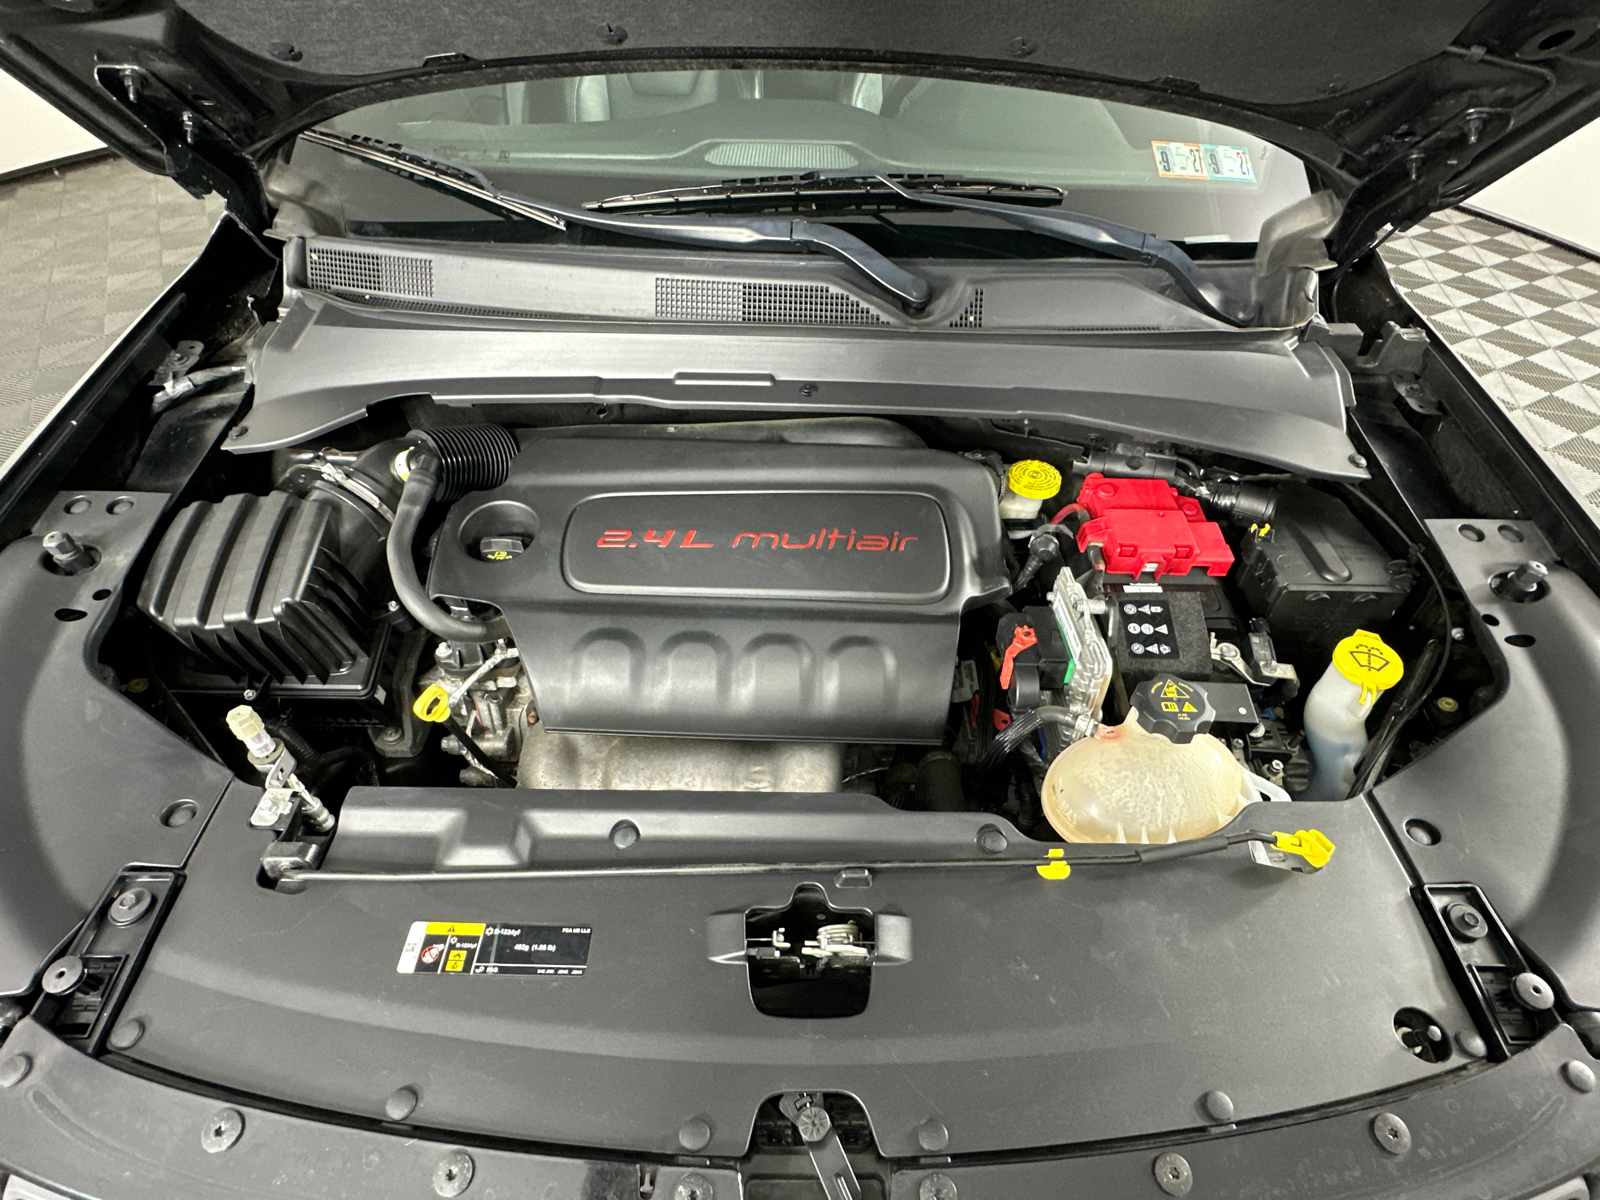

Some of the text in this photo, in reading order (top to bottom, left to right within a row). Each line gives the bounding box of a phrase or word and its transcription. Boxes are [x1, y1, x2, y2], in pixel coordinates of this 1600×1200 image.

[1160, 151, 1171, 172] 9
[1209, 153, 1220, 175] 9
[732, 528, 918, 551] multiair
